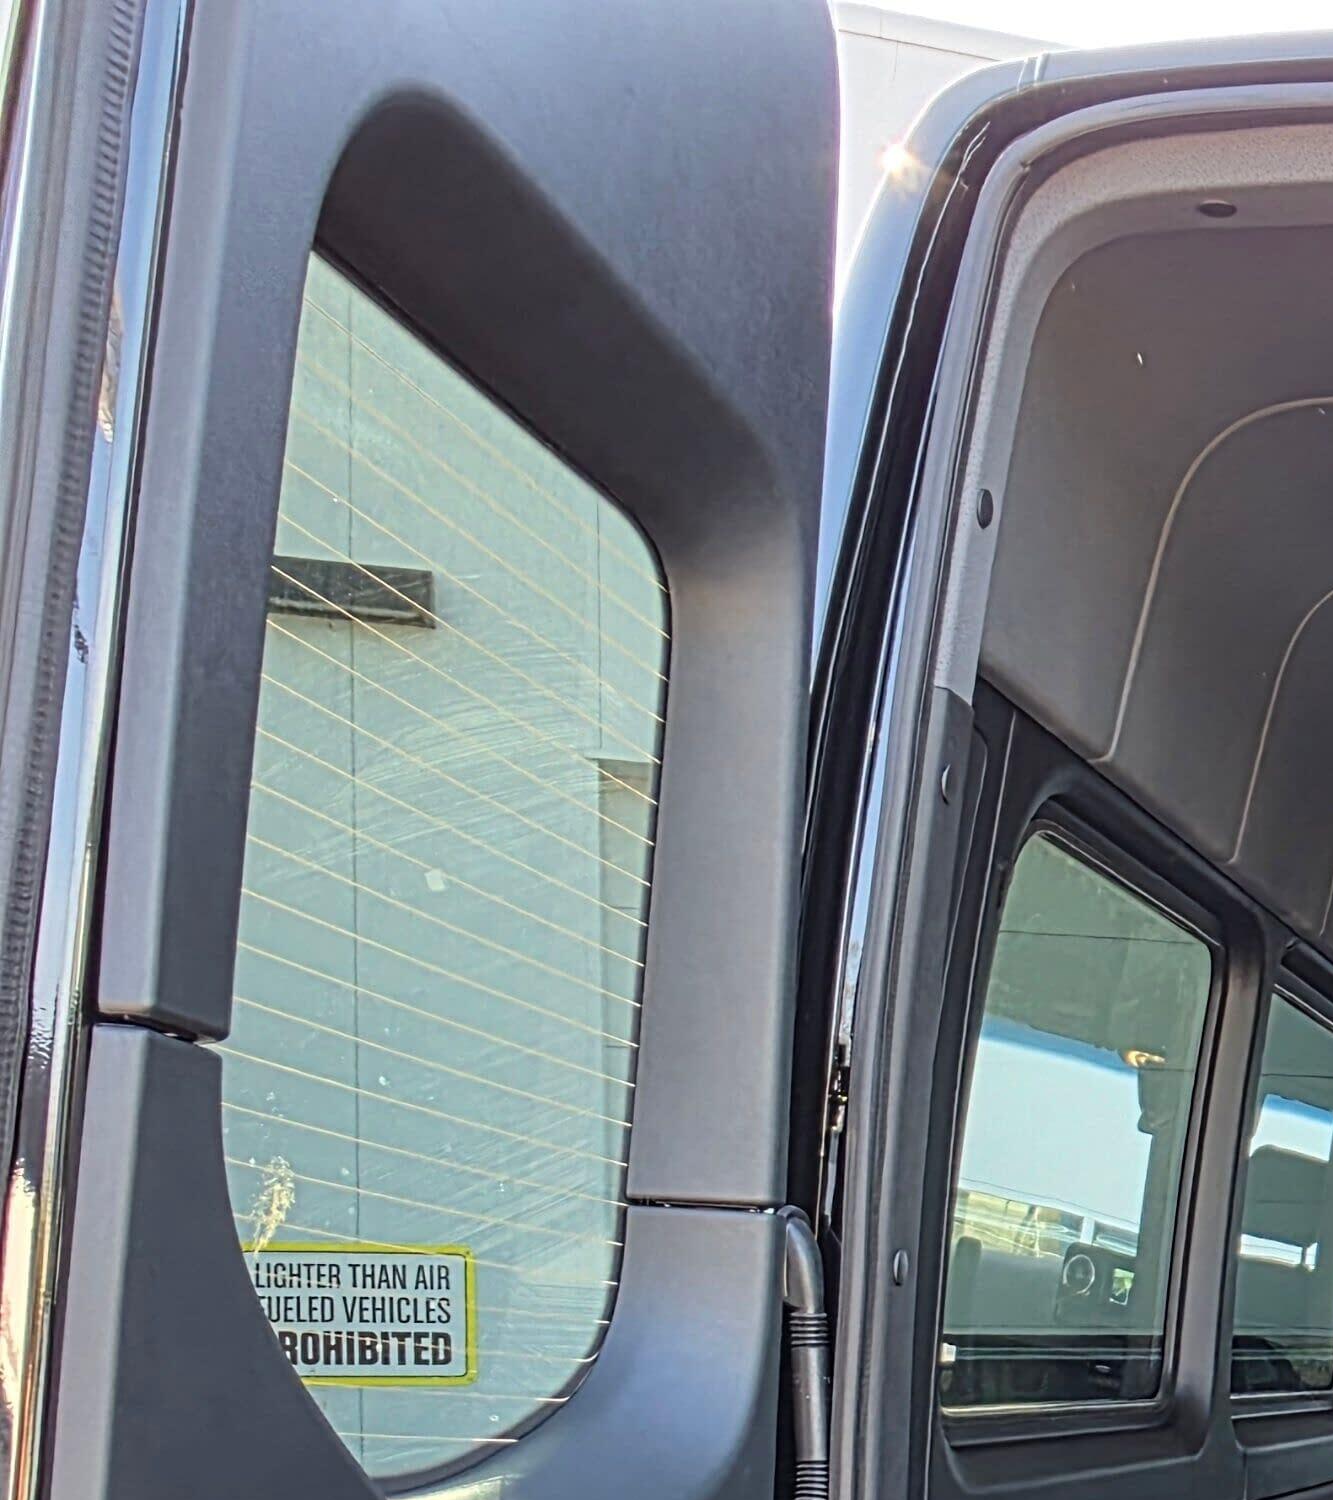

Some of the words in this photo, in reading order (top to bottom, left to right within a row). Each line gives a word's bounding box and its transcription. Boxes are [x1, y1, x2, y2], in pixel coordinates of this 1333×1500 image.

[255, 1263, 340, 1289] LIGHTER
[348, 1263, 407, 1290] THAN
[414, 1264, 451, 1291] AIR
[258, 1296, 334, 1323] UELED
[342, 1296, 451, 1324] VEHICLES
[278, 1331, 452, 1366] ROHIBITED
